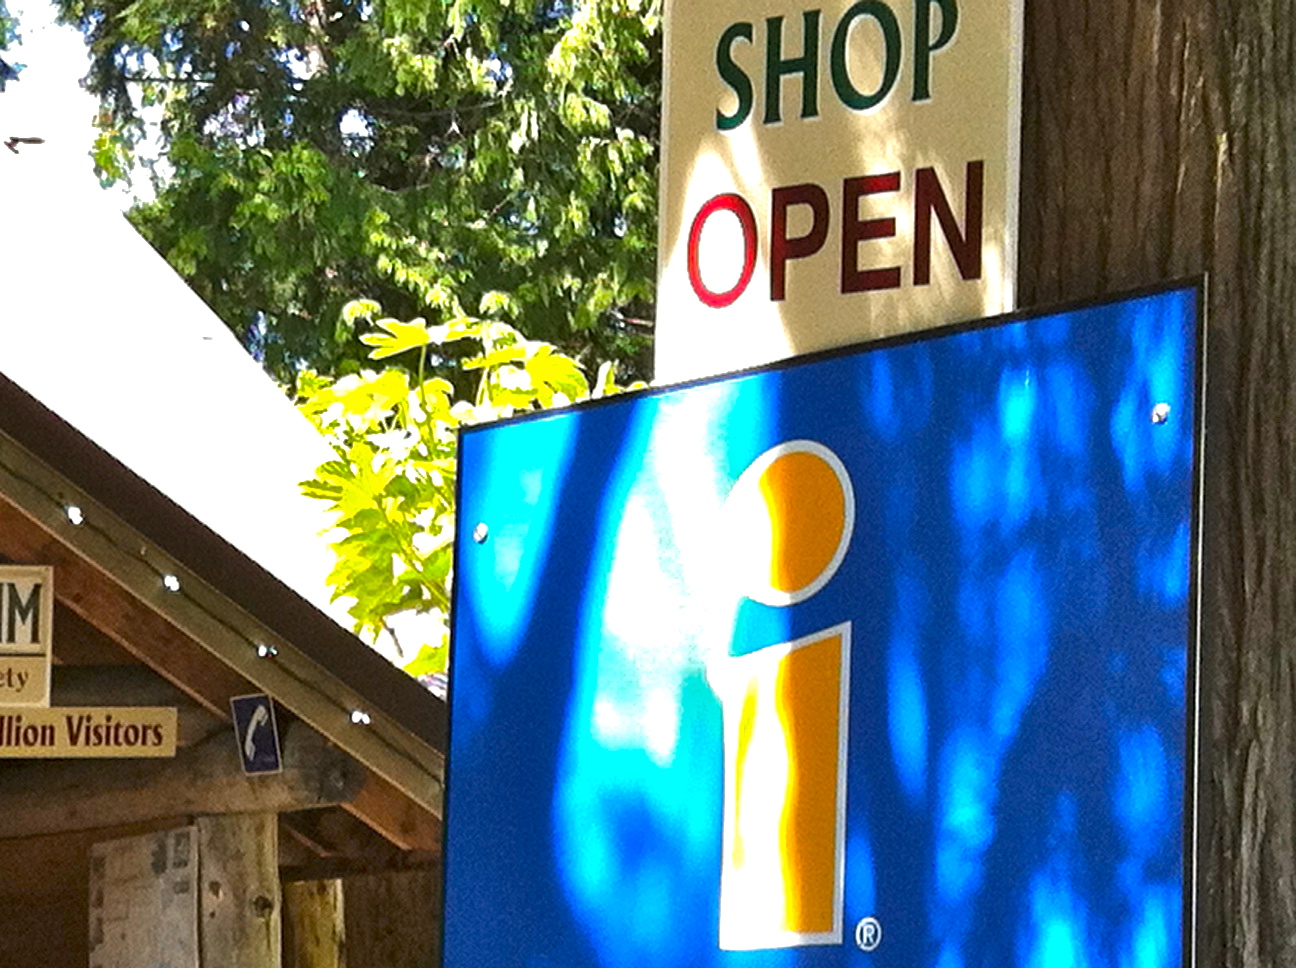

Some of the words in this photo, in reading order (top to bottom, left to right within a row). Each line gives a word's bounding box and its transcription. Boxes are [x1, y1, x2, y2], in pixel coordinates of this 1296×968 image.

[715, 0, 960, 131] SHOP
[687, 160, 984, 308] OPEN
[64, 713, 164, 747] Visitors
